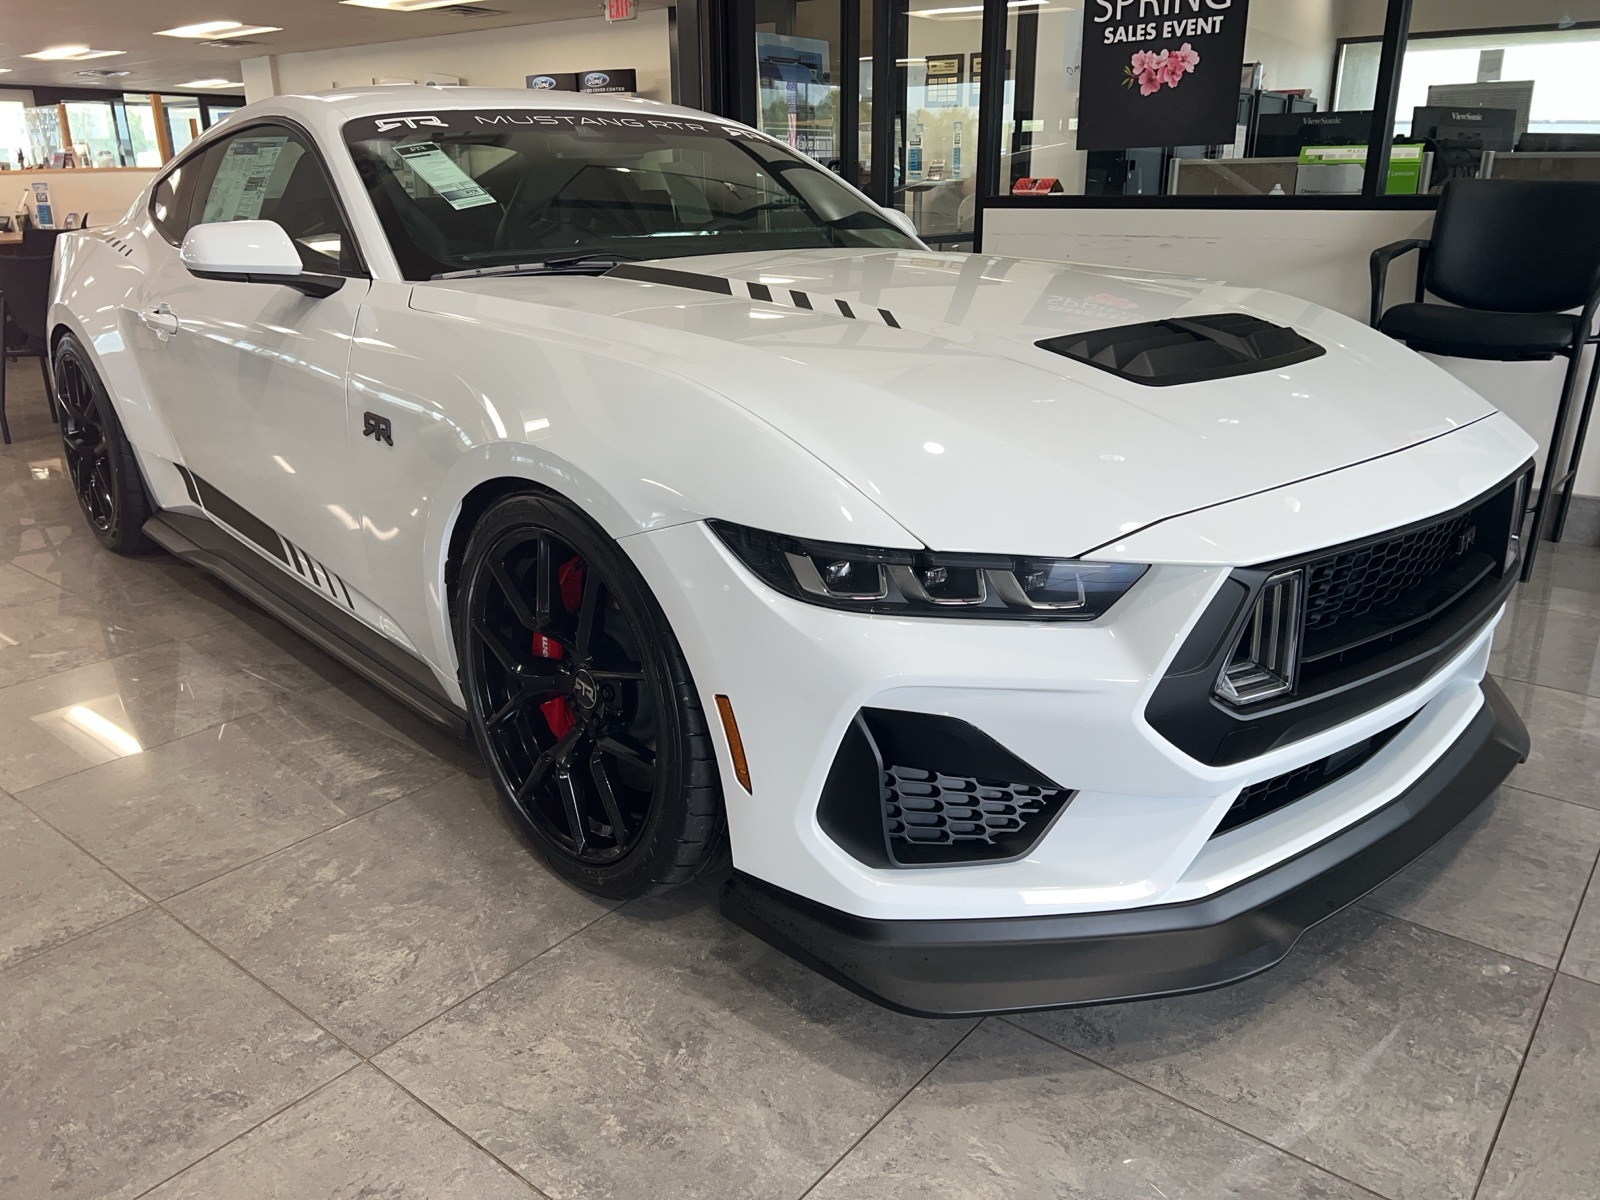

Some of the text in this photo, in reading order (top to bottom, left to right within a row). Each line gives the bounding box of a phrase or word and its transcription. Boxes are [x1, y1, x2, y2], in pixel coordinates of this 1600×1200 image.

[609, 0, 629, 18] EXIT
[1094, 0, 1232, 22] SPR
[1103, 15, 1224, 44] SALES EVENT
[474, 115, 709, 132] MUSTANG RTR
[1302, 116, 1342, 125] ViewSonic
[1451, 112, 1483, 121] ViewSonic
